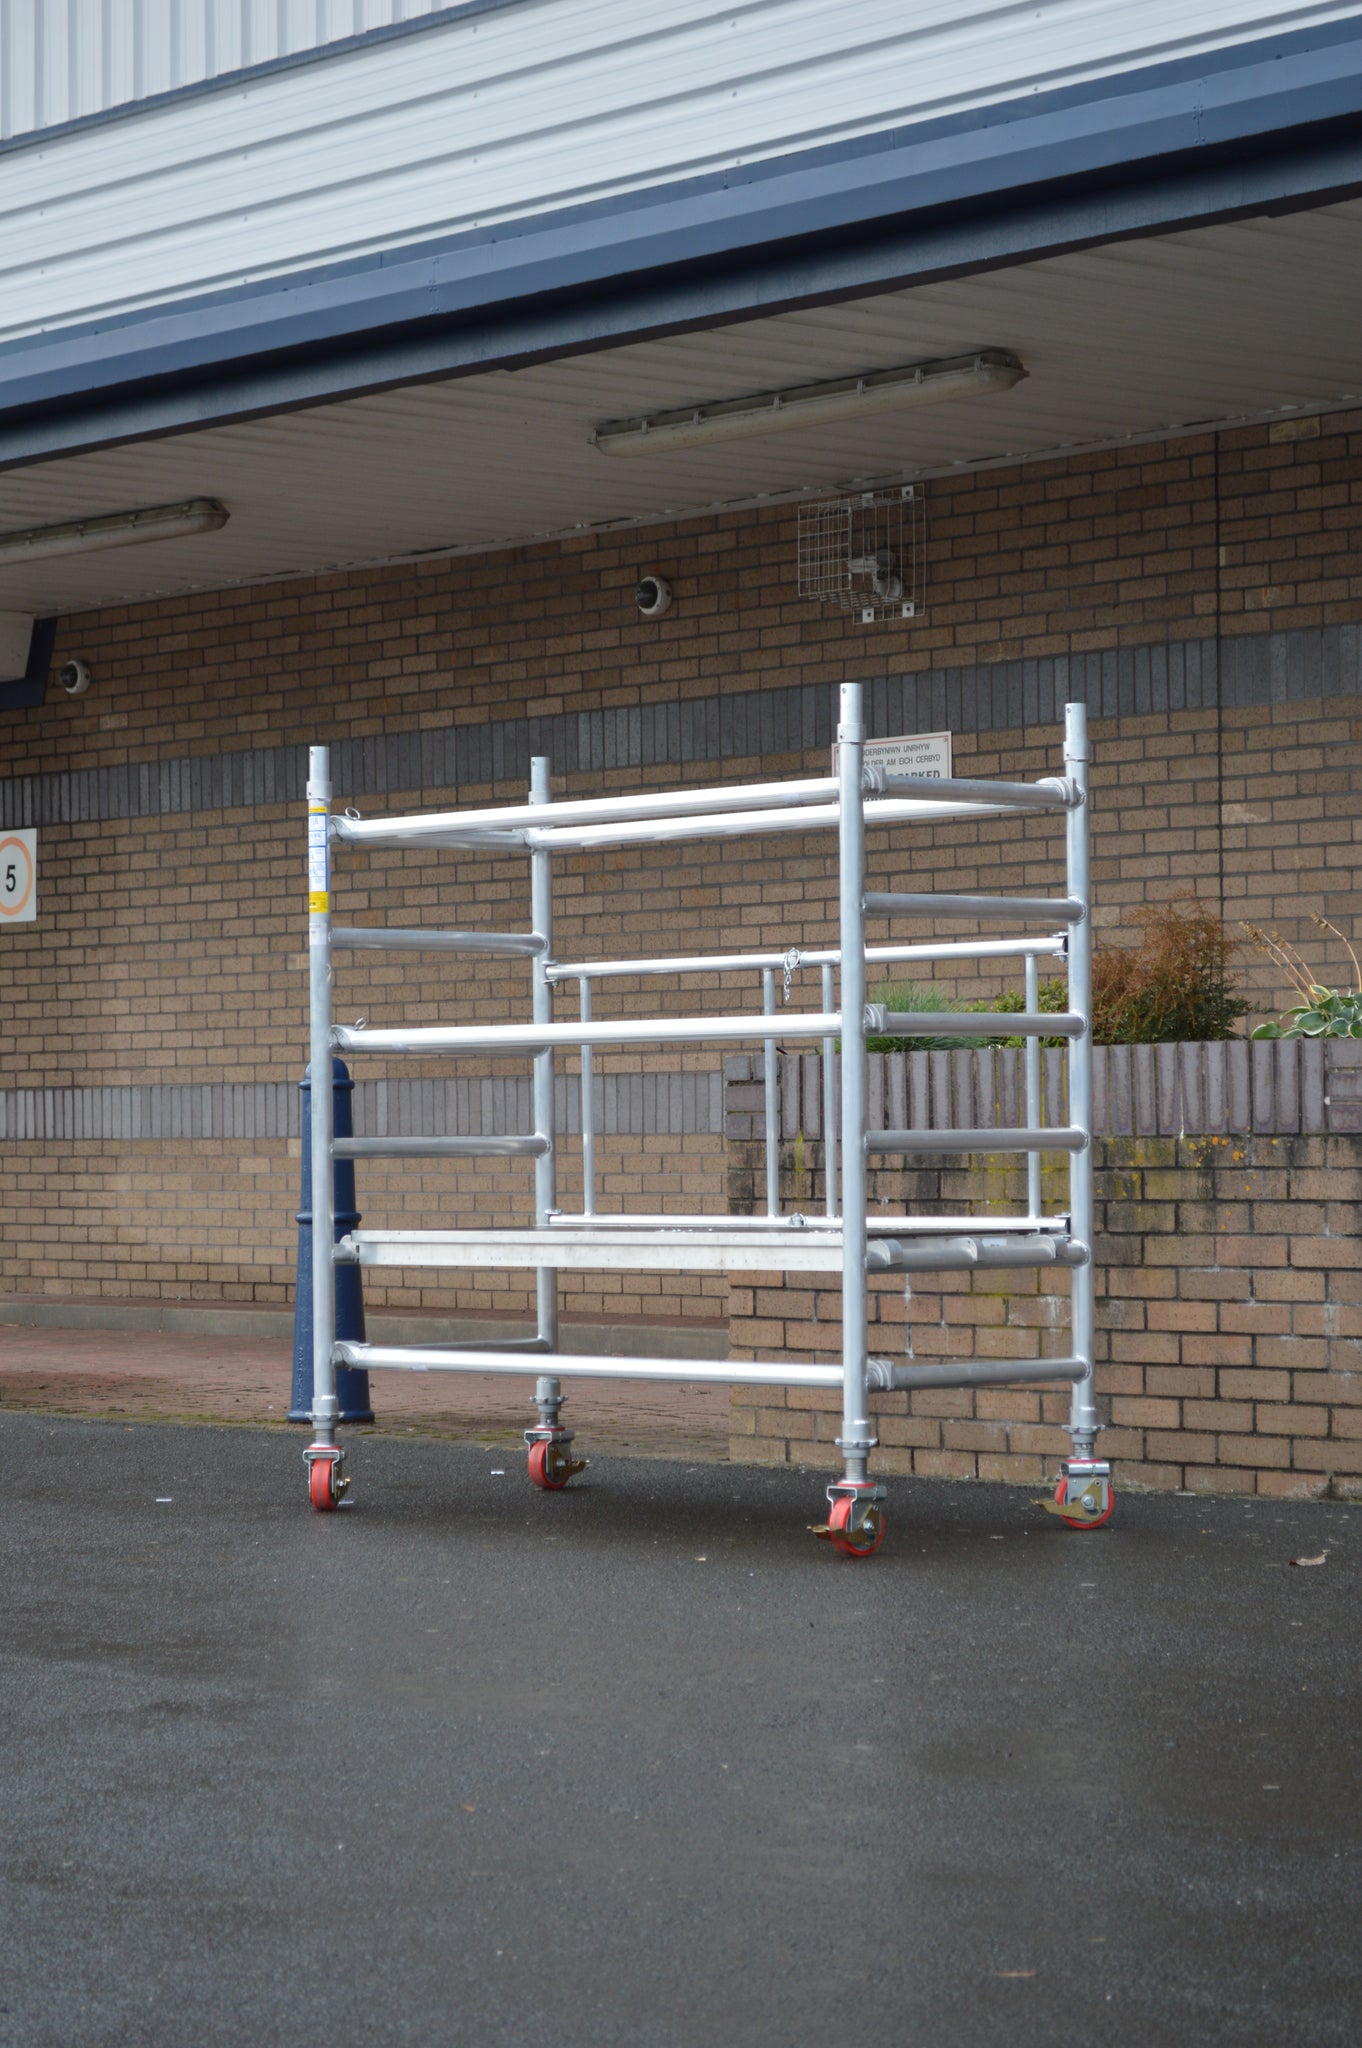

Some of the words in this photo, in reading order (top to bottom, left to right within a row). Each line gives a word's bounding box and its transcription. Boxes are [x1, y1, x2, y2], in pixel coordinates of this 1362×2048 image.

[903, 743, 931, 753] UNRHYW
[886, 758, 897, 766] AM
[899, 756, 913, 766] EICH
[916, 753, 941, 764] CERBYD
[897, 770, 941, 778] KED
[5, 864, 16, 893] 5
